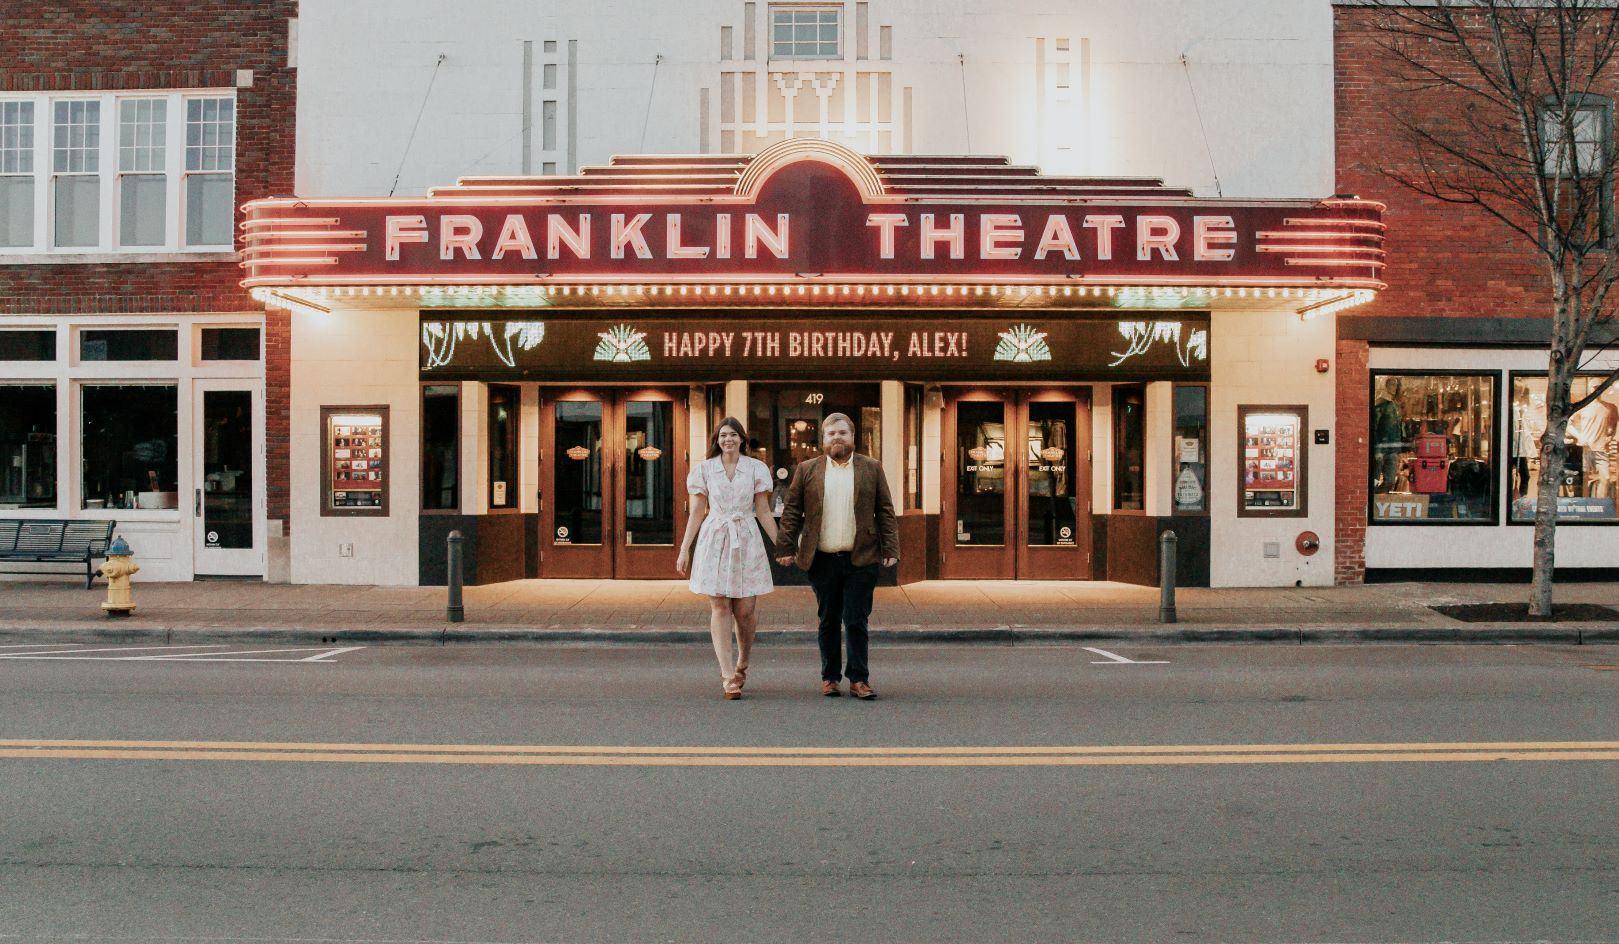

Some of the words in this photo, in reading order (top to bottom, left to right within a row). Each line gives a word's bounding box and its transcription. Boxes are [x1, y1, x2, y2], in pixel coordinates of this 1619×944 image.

[385, 213, 790, 261] FRANKLIN
[865, 213, 1238, 261] THEATRE
[663, 332, 735, 357] HAPPY
[741, 332, 780, 357] 7TH
[789, 332, 899, 361] BIRTHDAY,
[907, 332, 968, 357] ALEX!
[805, 393, 824, 405] 419
[1375, 503, 1422, 518] YETI
